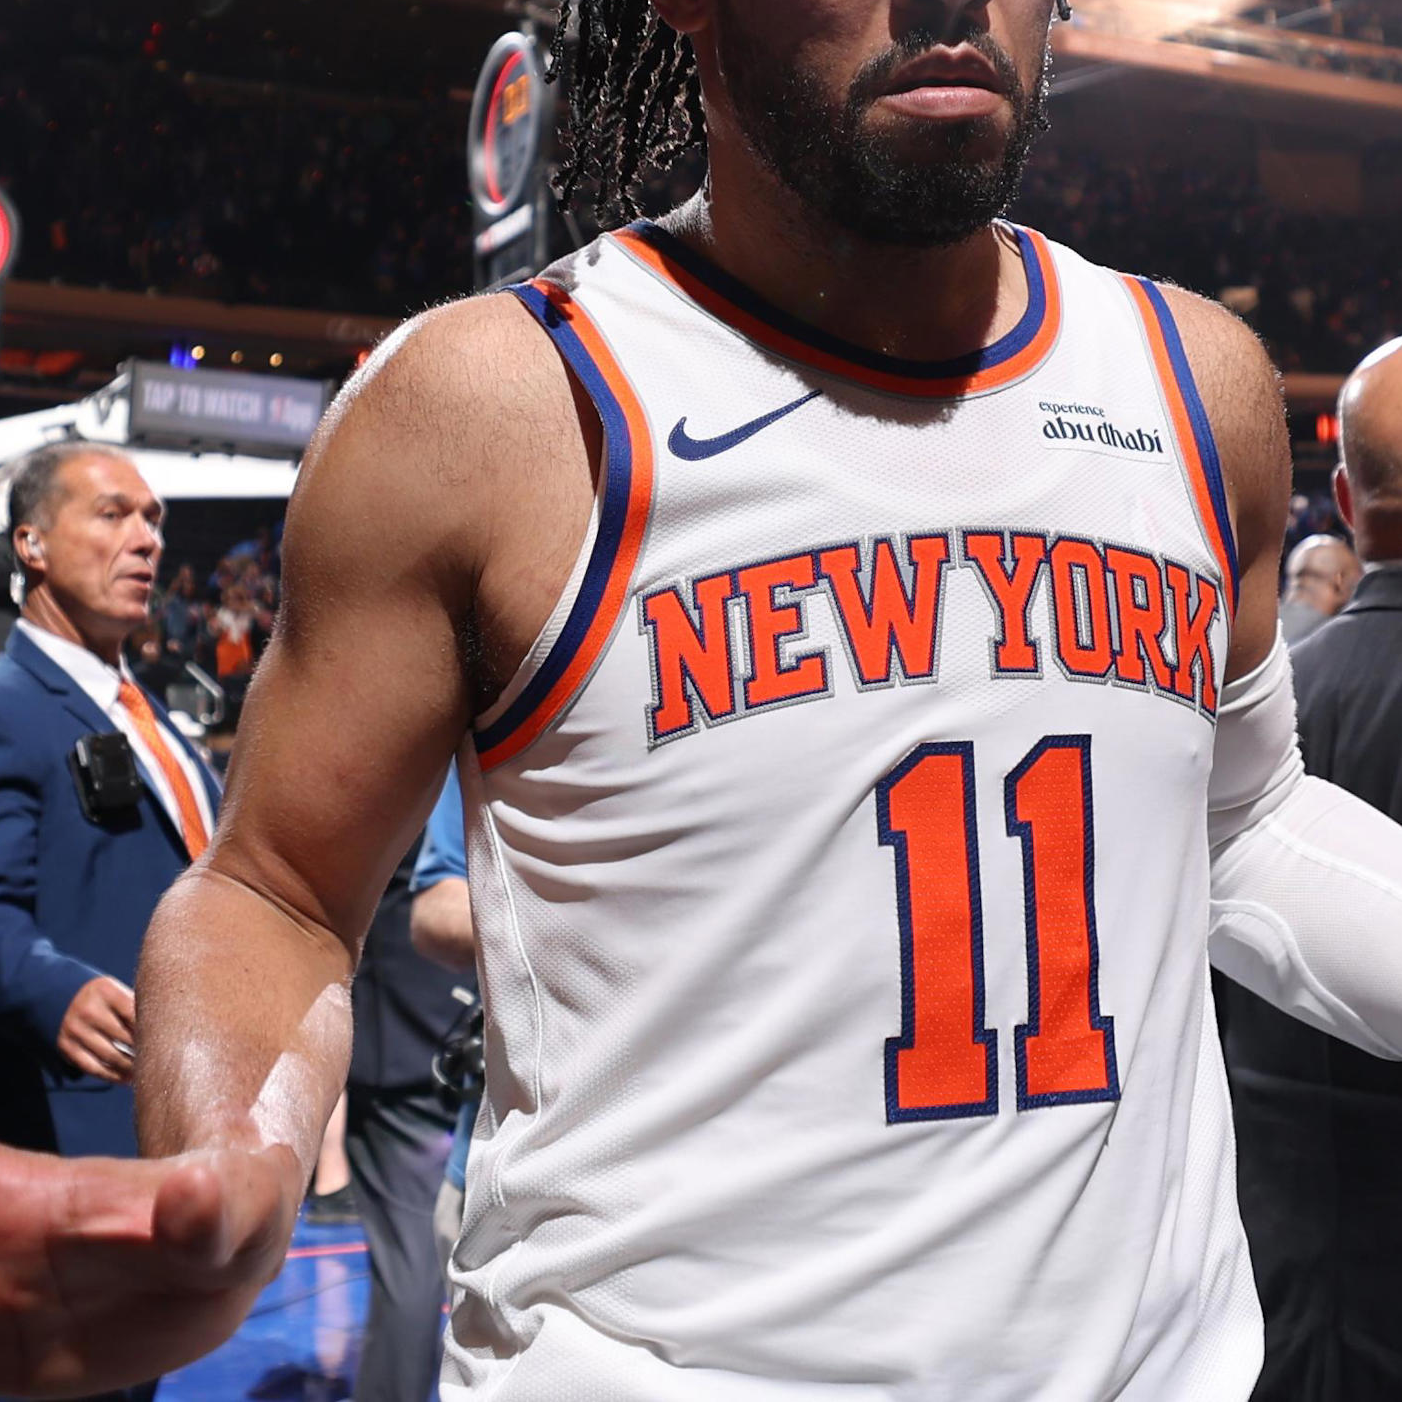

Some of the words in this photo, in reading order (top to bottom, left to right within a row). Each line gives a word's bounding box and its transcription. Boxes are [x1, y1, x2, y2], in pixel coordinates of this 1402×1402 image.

[1039, 401, 1105, 418] experience
[1043, 416, 1096, 442] abu
[1096, 421, 1164, 454] dhabi
[638, 528, 955, 747] NEW
[956, 526, 1223, 724] YORK
[876, 733, 1121, 1125] 11
